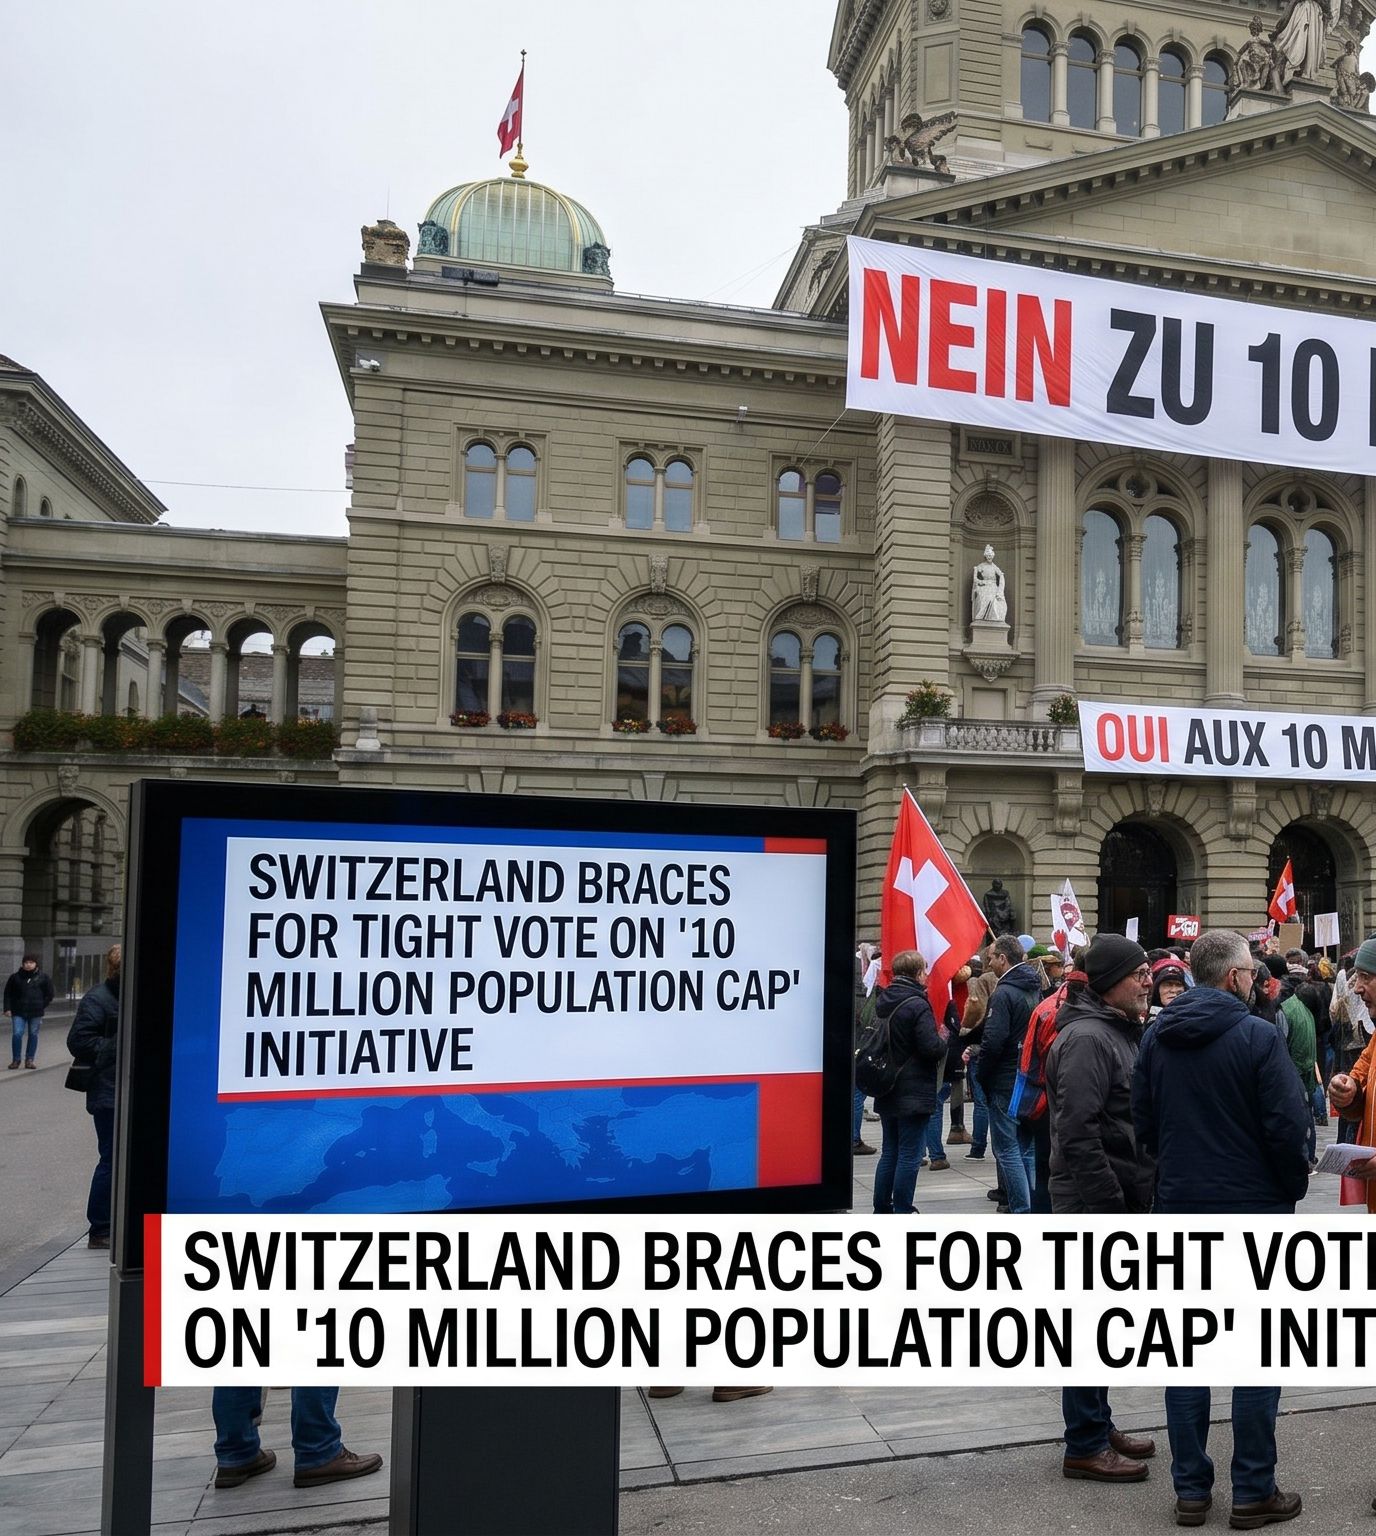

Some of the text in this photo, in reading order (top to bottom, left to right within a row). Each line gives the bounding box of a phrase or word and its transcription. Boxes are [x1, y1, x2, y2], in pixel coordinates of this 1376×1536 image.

[860, 268, 1072, 407] NEIN
[1106, 308, 1215, 426] ZU
[1249, 332, 1340, 442] 10
[1097, 713, 1169, 763] OUI
[1184, 718, 1270, 767] AUX
[1281, 723, 1328, 770] 10
[248, 853, 731, 906] SWITZERLAND BRACES
[248, 912, 735, 960] FOR TIGHT VOTE ON '10
[246, 969, 800, 1018] MILLION POPULATION CAP'
[244, 1027, 474, 1078] INITIATIVE
